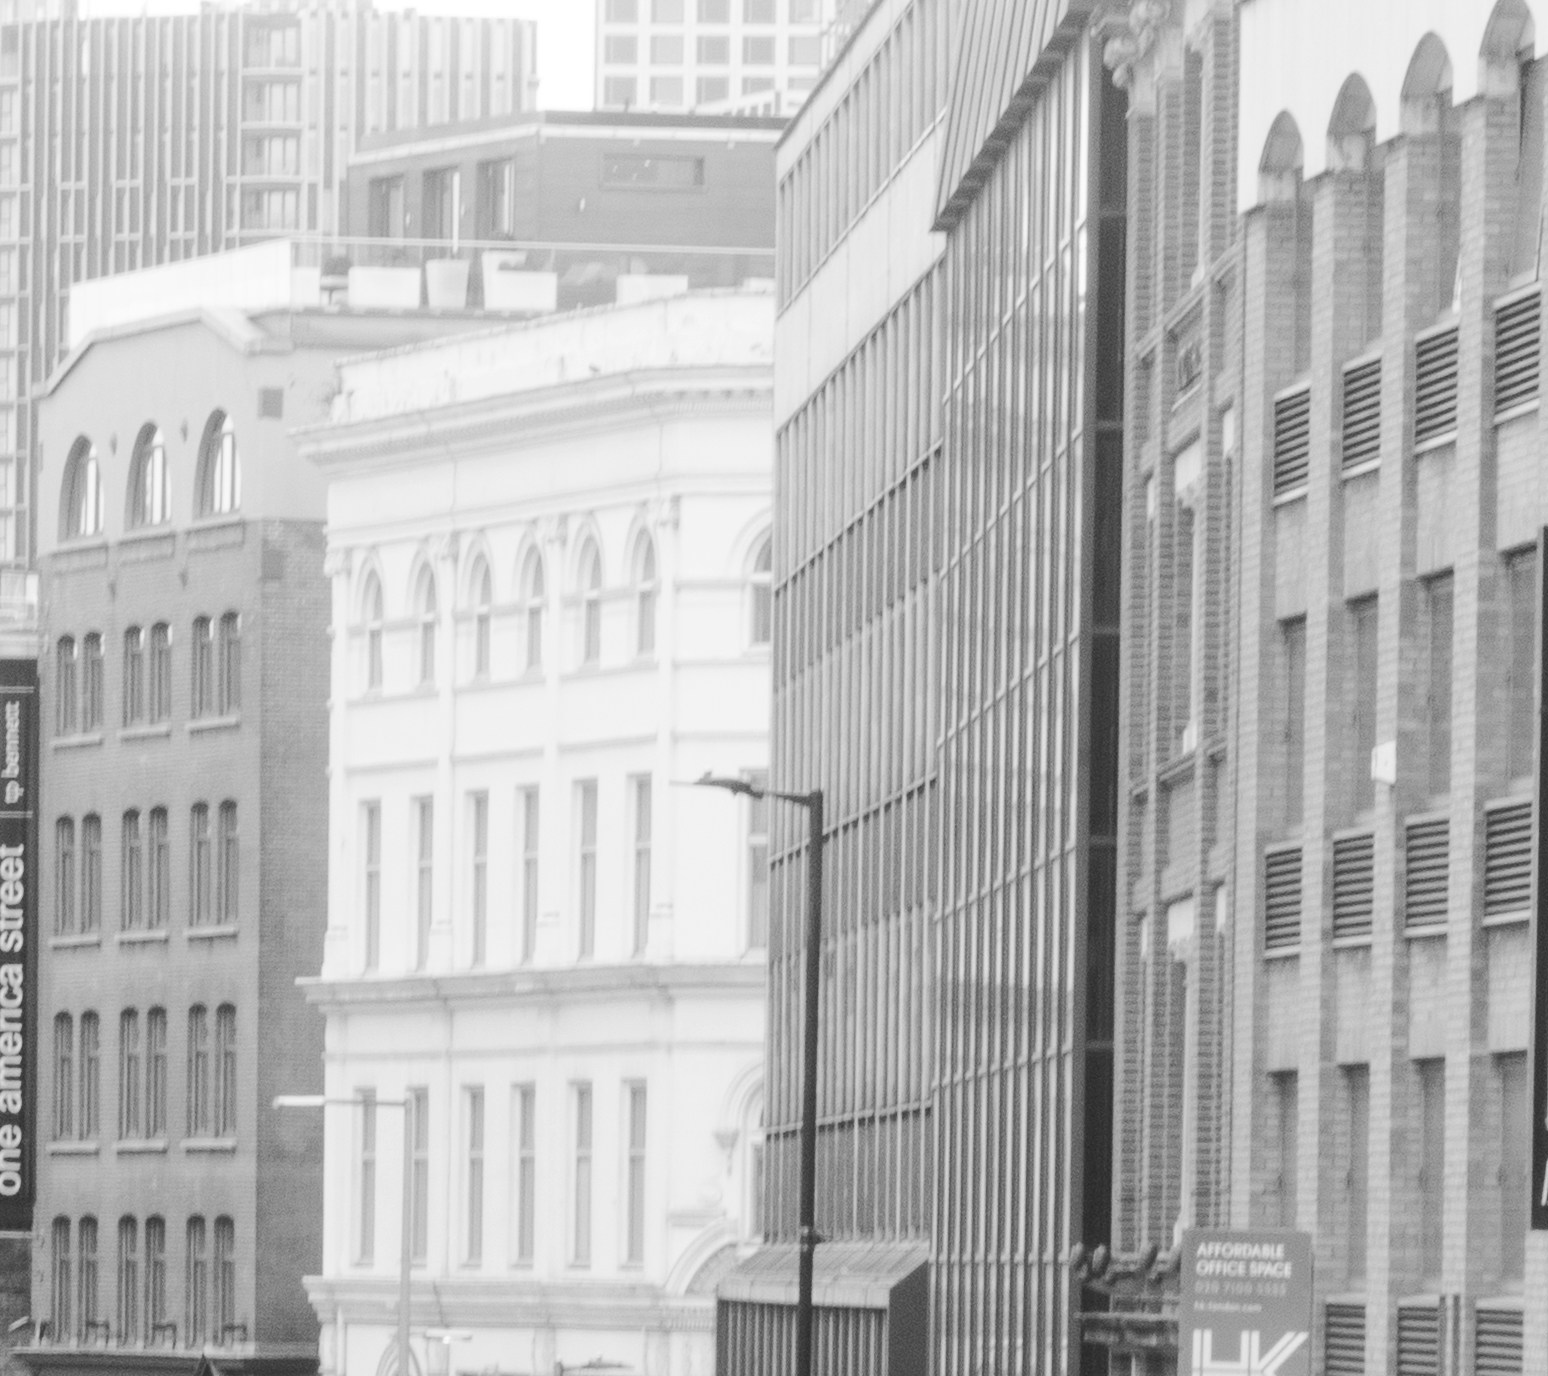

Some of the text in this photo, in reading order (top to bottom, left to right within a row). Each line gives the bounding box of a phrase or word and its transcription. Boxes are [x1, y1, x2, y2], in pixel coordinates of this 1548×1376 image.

[1195, 1241, 1285, 1260] AFFORDABLE
[1195, 1259, 1293, 1279] OFFICE SPACE
